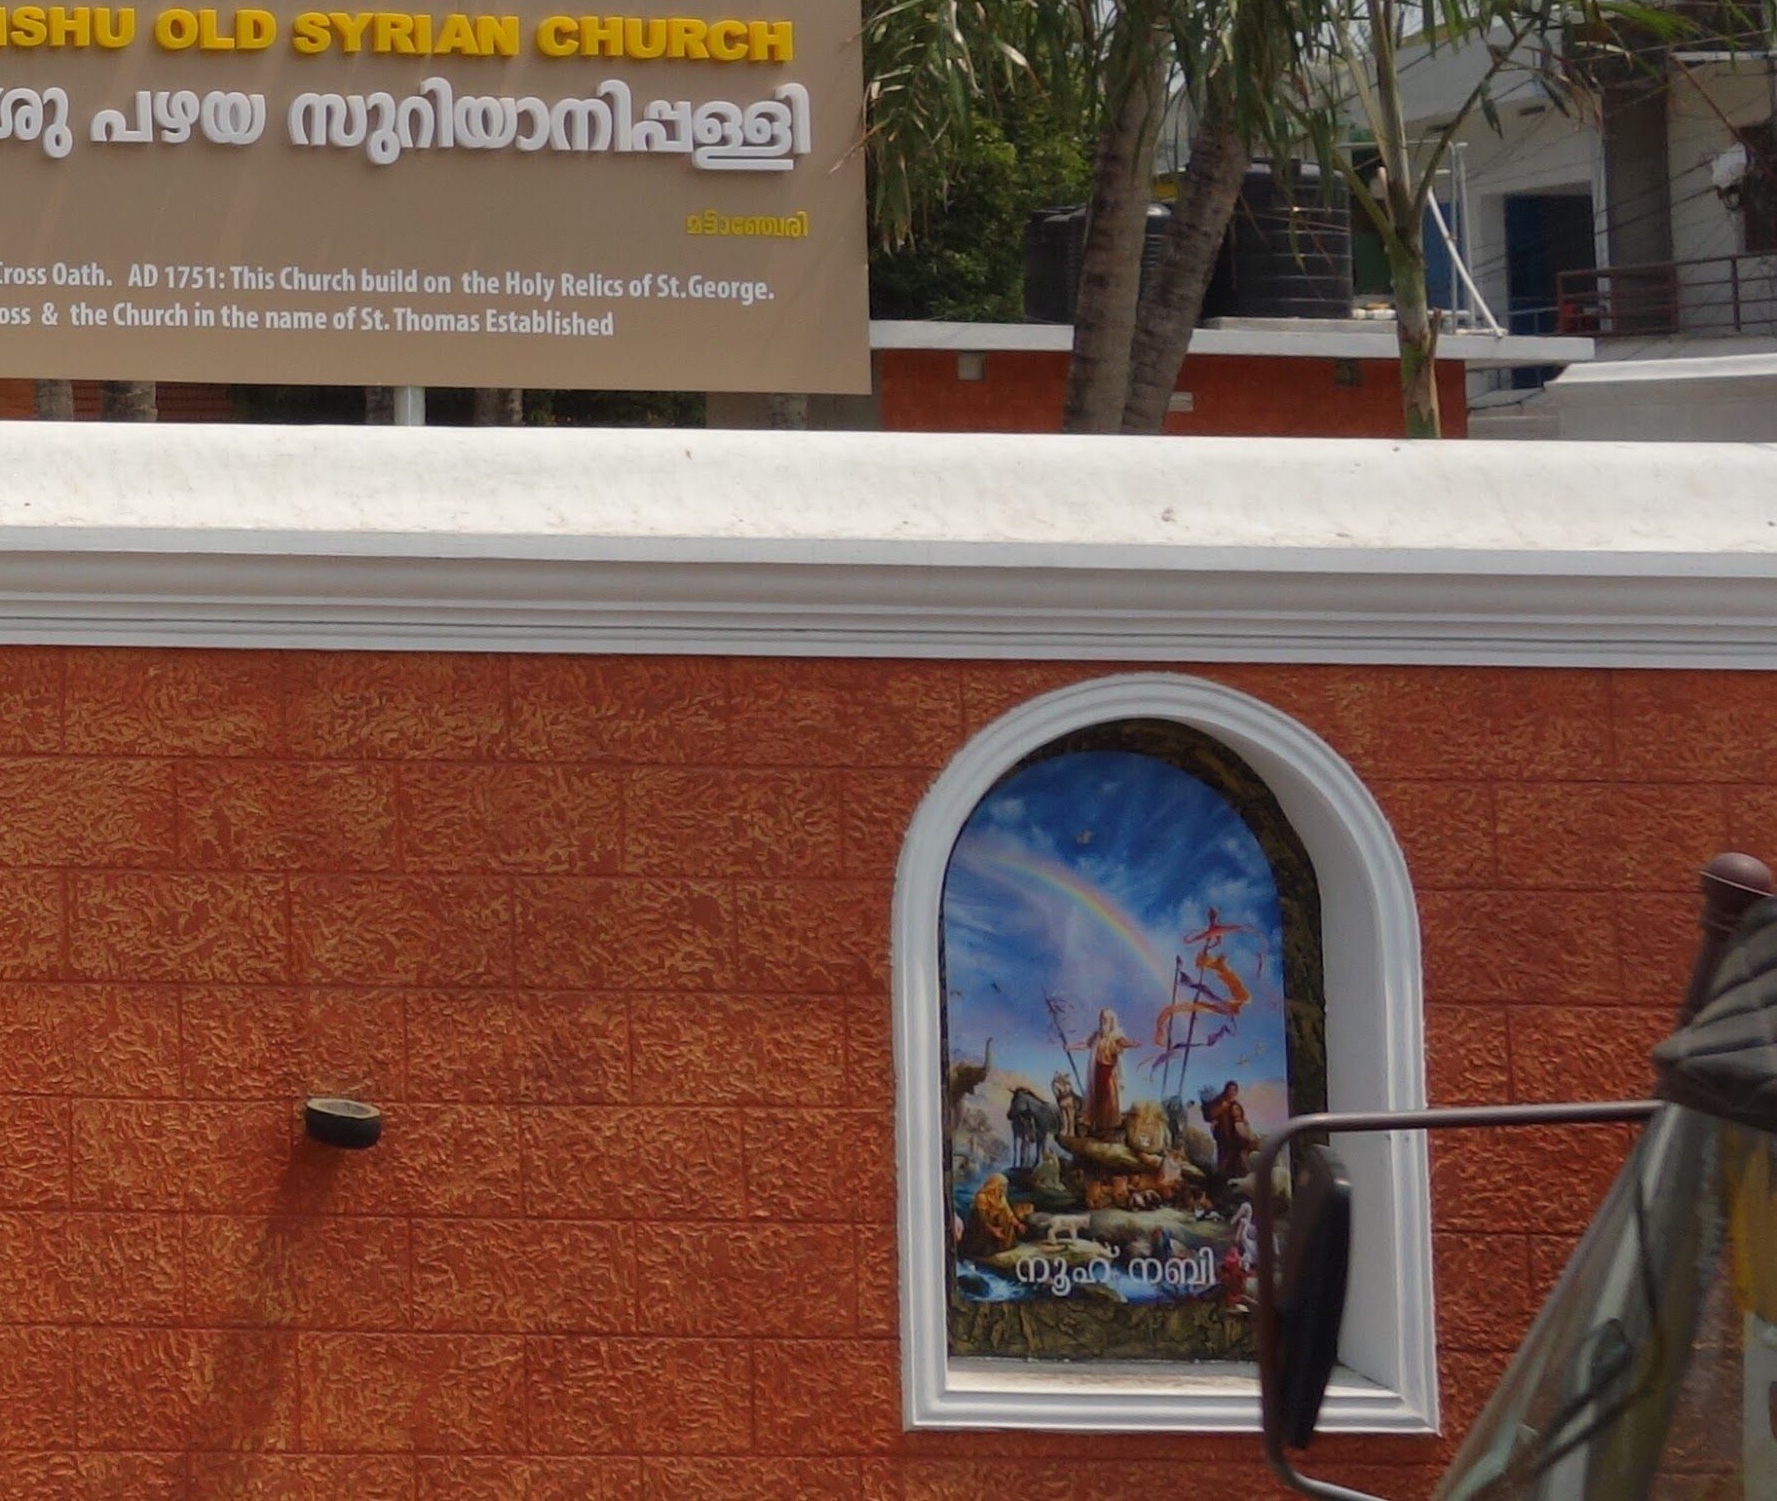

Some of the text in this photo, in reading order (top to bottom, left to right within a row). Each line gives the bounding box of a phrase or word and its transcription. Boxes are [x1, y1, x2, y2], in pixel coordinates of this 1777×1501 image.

[153, 8, 277, 52] OLD
[292, 12, 521, 57] SYRIAN
[534, 16, 795, 62] CHURCH
[90, 88, 266, 146] പഴയ
[52, 261, 113, 287] Oath.
[128, 263, 159, 288] AD
[165, 263, 226, 290] 1751:
[230, 266, 275, 291] This
[280, 266, 356, 293] Church
[361, 268, 419, 294] build
[423, 275, 451, 295] on
[462, 271, 500, 295] the
[505, 271, 555, 301] Holy
[562, 273, 625, 298] Relics
[629, 273, 653, 298] of
[41, 302, 58, 326] &
[70, 302, 108, 326] the
[113, 302, 189, 328] Church
[193, 305, 215, 327] in
[221, 305, 259, 328] the
[265, 310, 328, 331] name
[333, 306, 357, 331] of
[486, 310, 614, 337] Established
[1128, 1246, 1217, 1286] നബി
